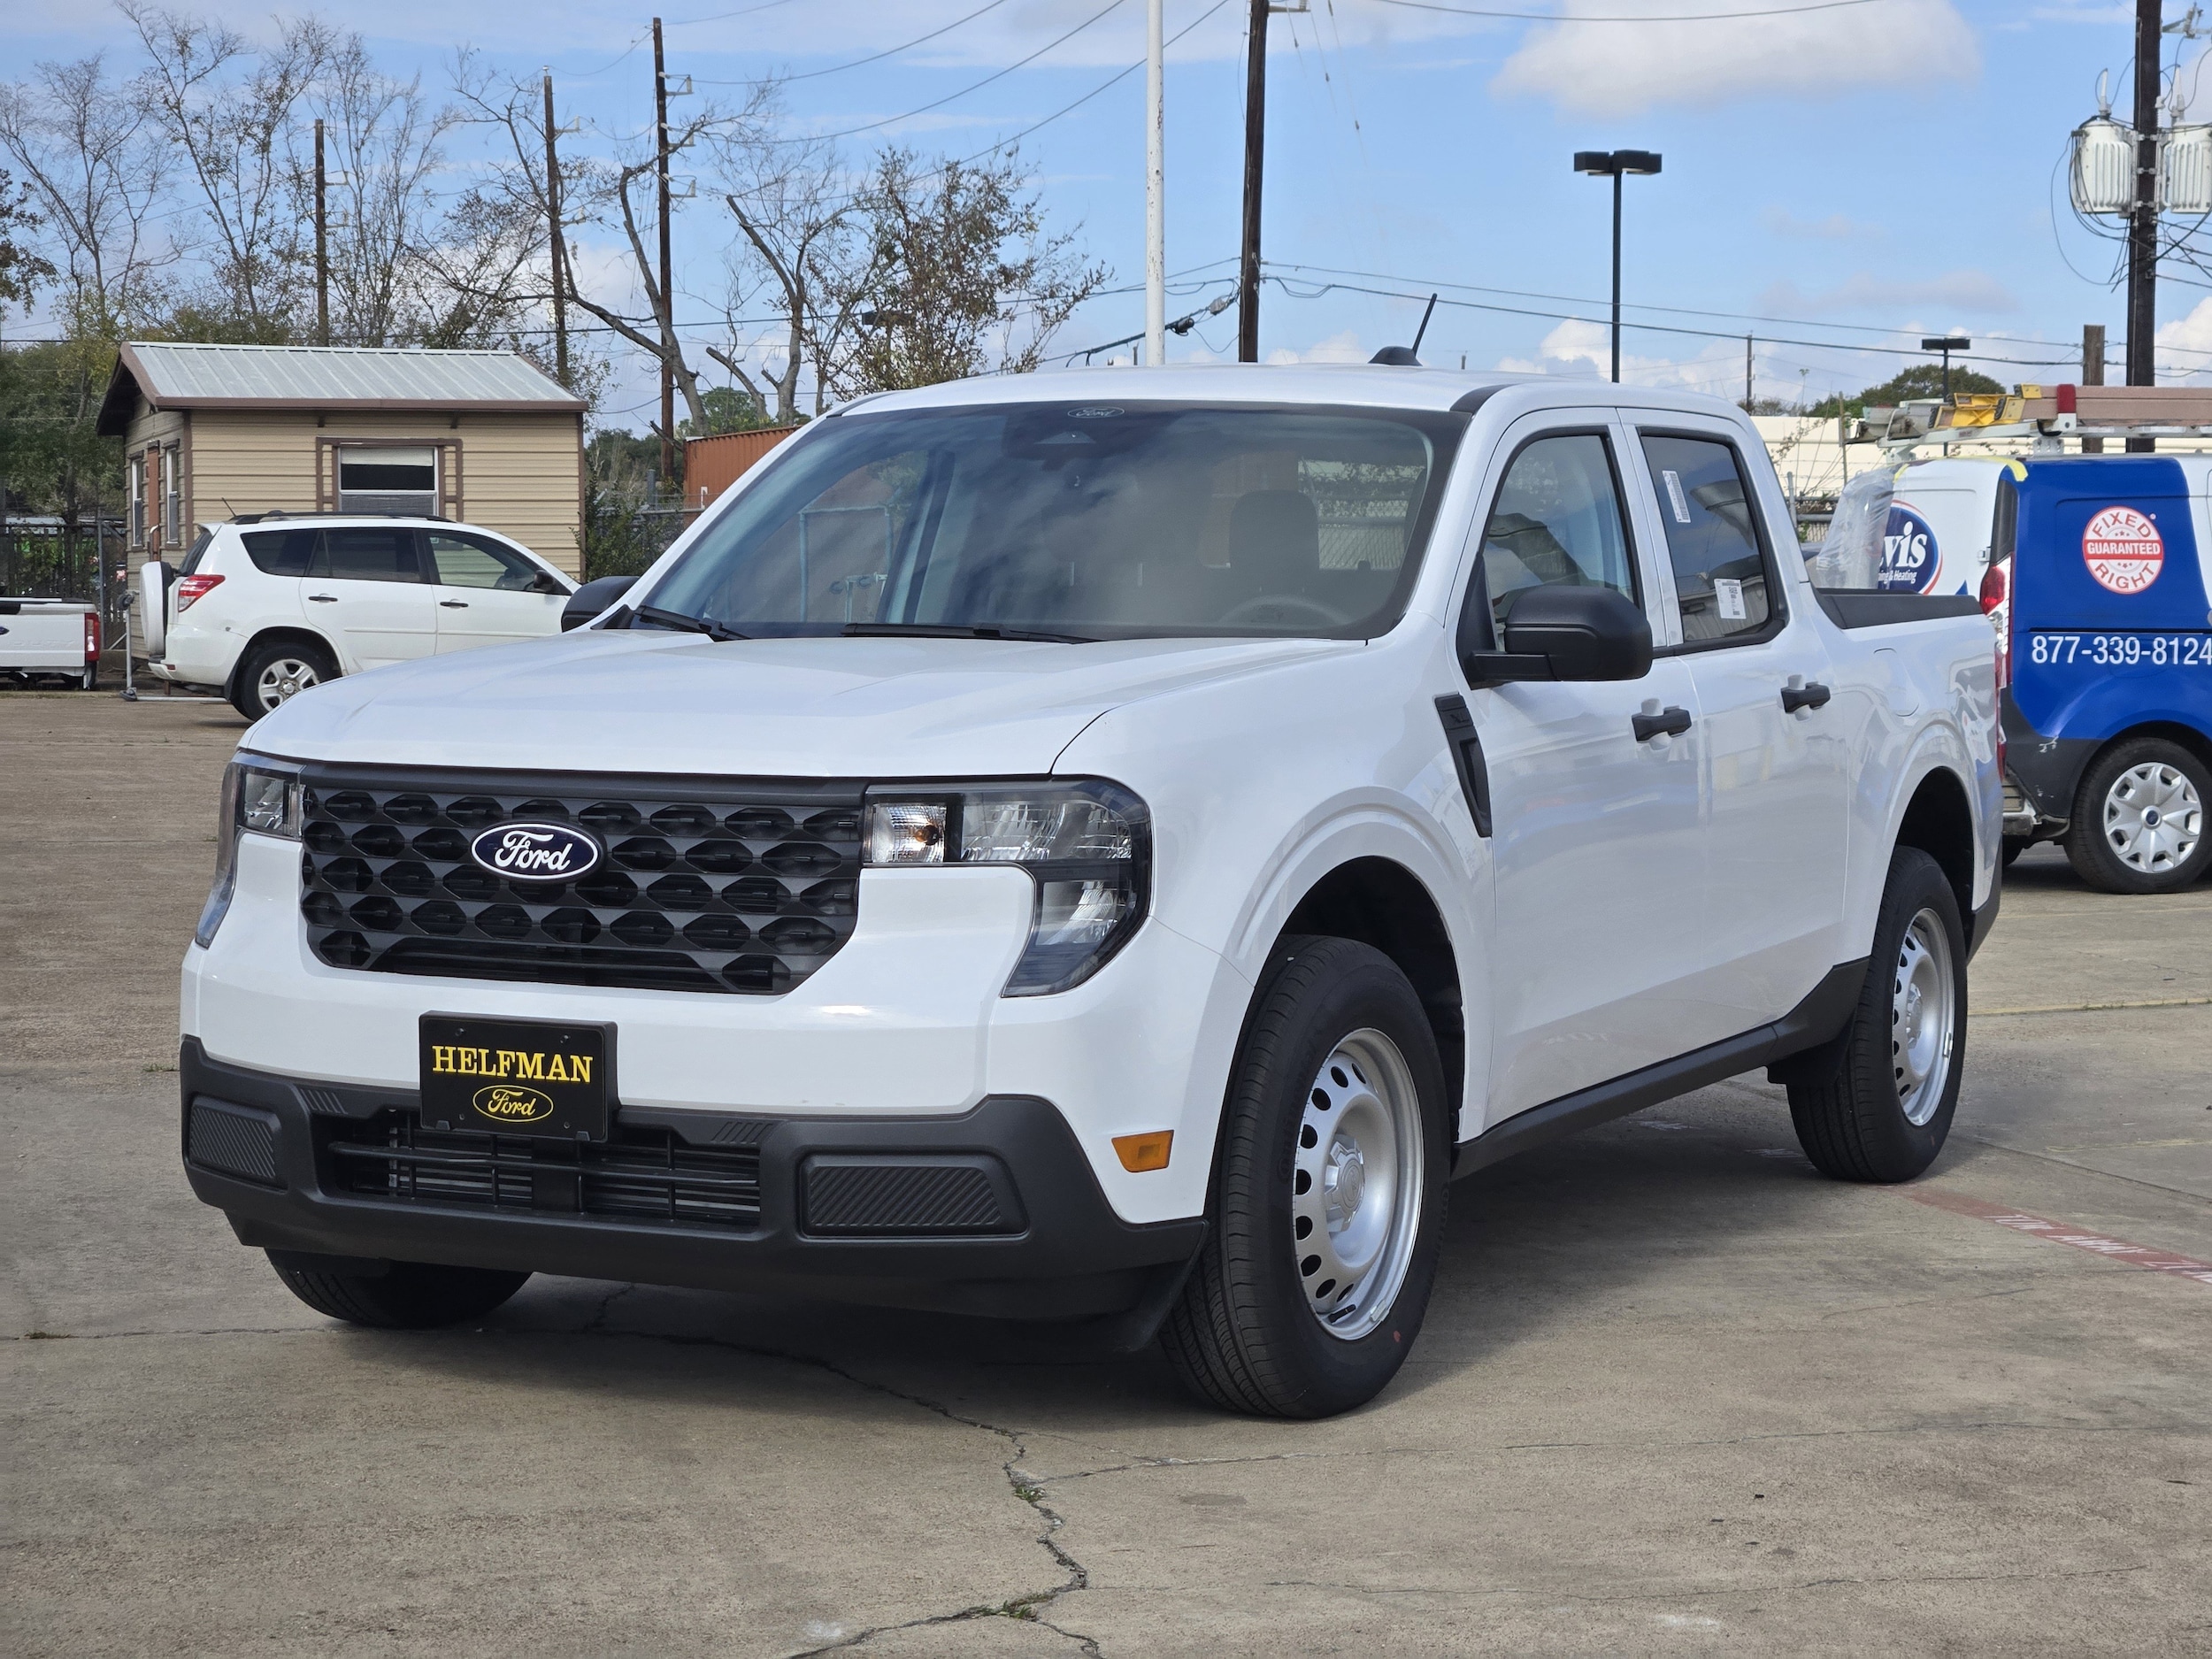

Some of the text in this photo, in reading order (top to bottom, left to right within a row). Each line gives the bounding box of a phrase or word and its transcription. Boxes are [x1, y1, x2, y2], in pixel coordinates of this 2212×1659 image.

[1075, 407, 1117, 417] Ford
[2092, 511, 2152, 538] FIXED
[1879, 520, 1928, 568] vis
[2086, 541, 2161, 556] GUARANTEED
[1893, 569, 1917, 584] Heating
[2094, 562, 2154, 589] RIGHT
[2032, 635, 2212, 665] 877-339-8124
[495, 830, 573, 871] Ford
[432, 1045, 594, 1083] HELFMAN
[488, 1088, 537, 1117] Ford
